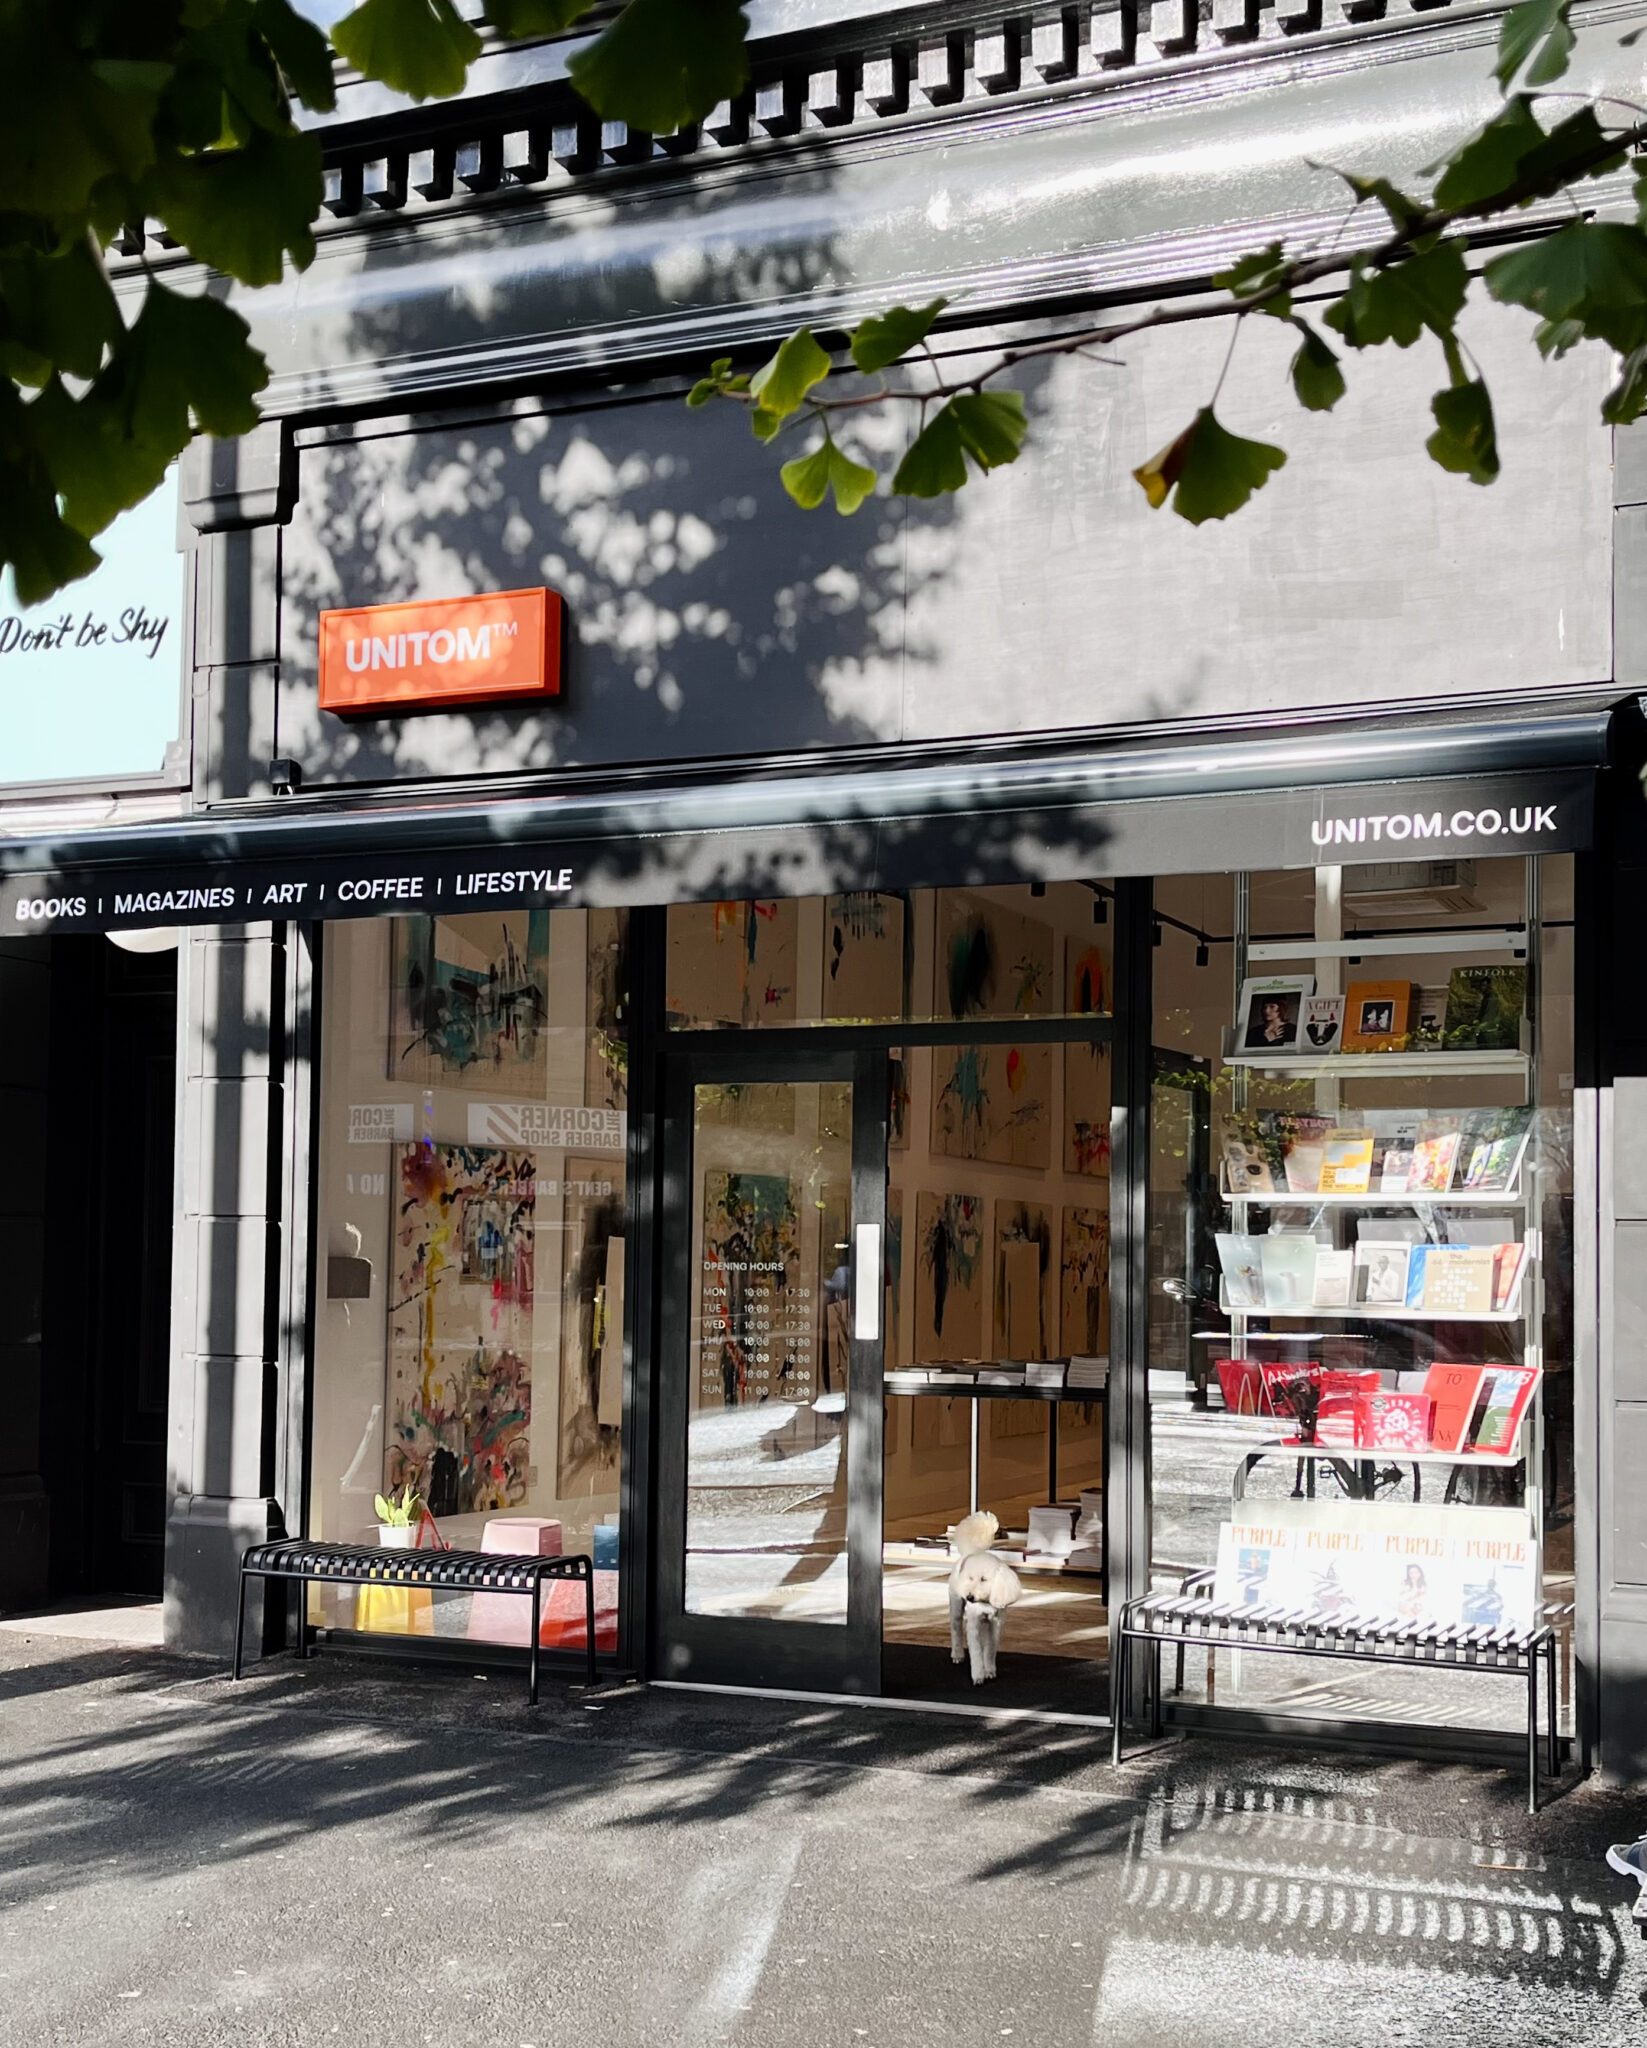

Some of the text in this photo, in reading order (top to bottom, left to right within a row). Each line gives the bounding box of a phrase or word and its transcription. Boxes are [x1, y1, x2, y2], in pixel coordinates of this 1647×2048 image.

[0, 605, 169, 660] Don't be Shy
[1311, 804, 1558, 845] UNITOM.CO.UK
[15, 868, 573, 921] BOOKS MAGAZINES ART COFFEE LIFESTYLE
[1459, 968, 1517, 979] KINFOLK
[703, 1262, 784, 1272] OPENING HOURS
[704, 1287, 727, 1297] MON
[703, 1304, 722, 1313] TUE
[703, 1320, 726, 1329] WED
[702, 1336, 724, 1345] THU
[701, 1352, 717, 1361] FRI
[701, 1368, 720, 1378] SAT
[1445, 1373, 1463, 1386] TO
[701, 1385, 722, 1394] SUN
[1232, 1525, 1287, 1547] PURPLE
[1307, 1530, 1364, 1551] PURPLE
[1385, 1535, 1445, 1557] PURPLE
[1465, 1539, 1526, 1562] PURPLE
